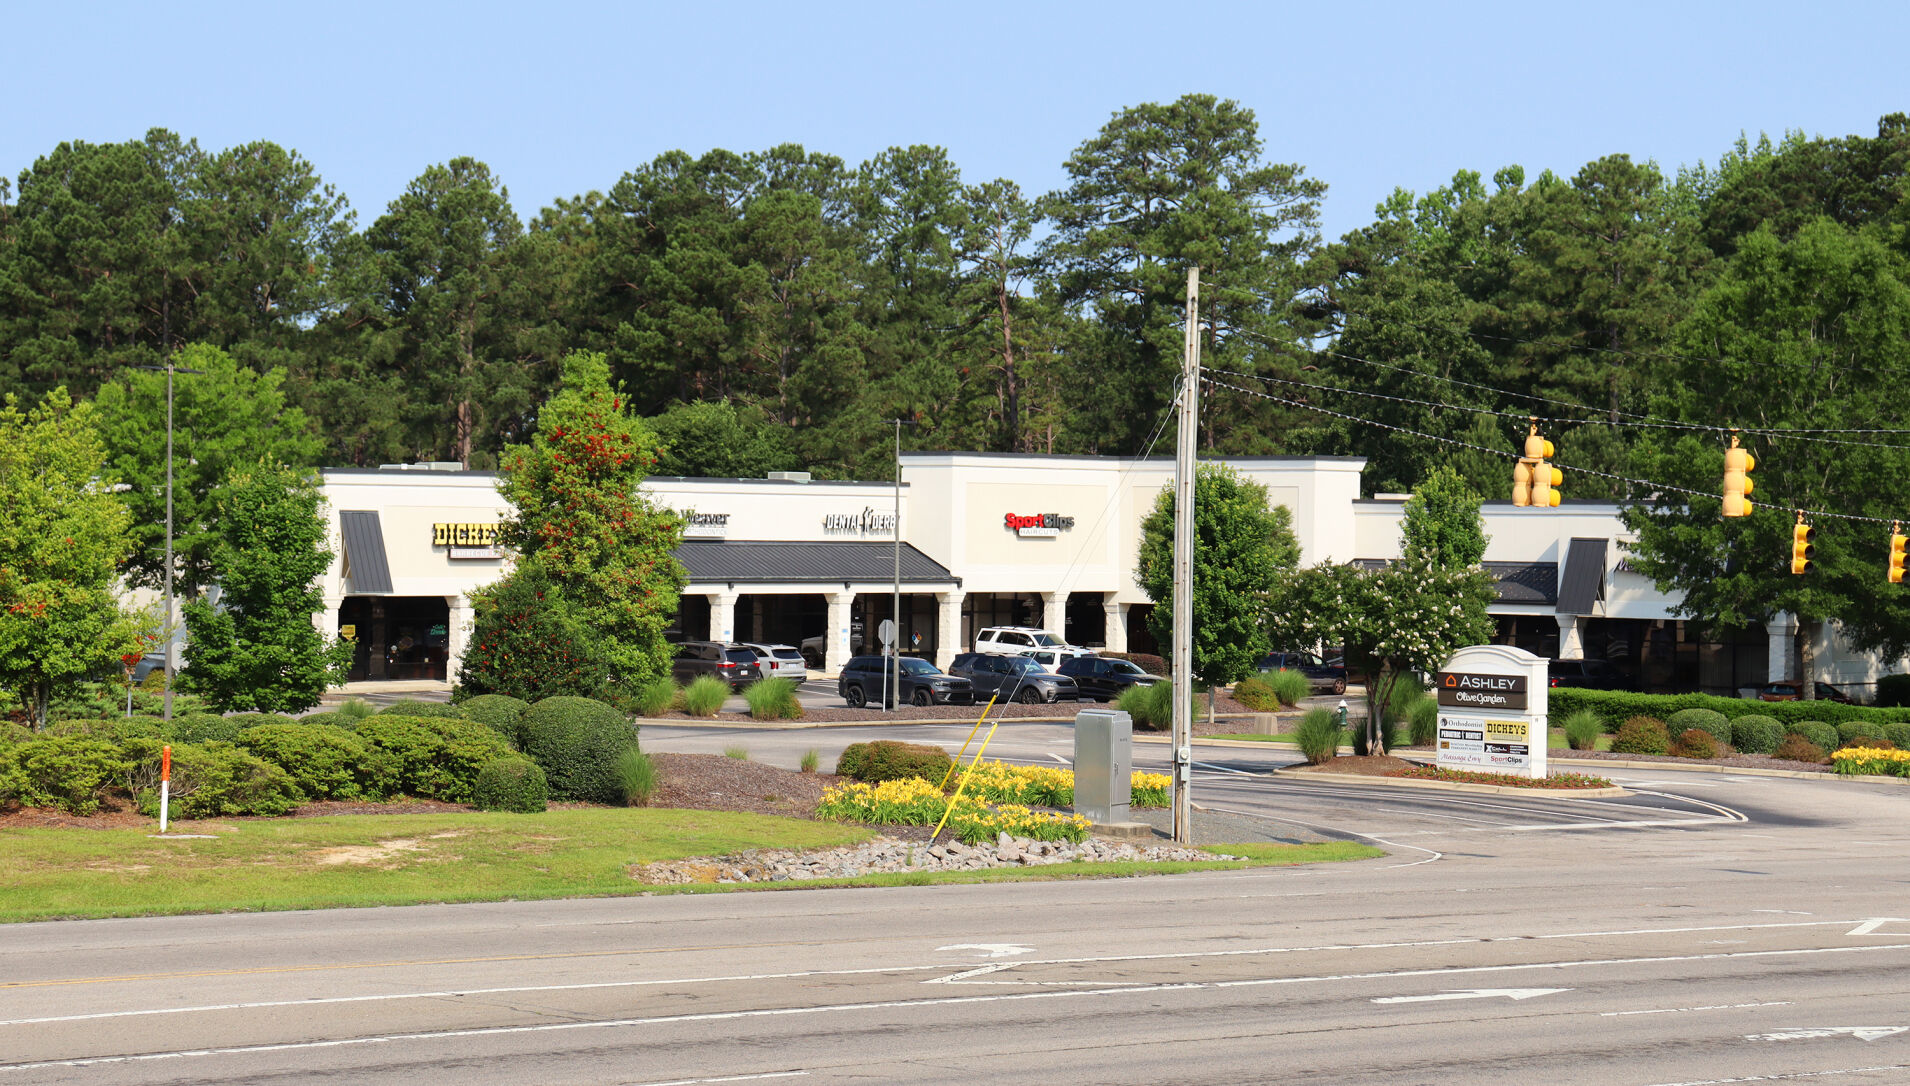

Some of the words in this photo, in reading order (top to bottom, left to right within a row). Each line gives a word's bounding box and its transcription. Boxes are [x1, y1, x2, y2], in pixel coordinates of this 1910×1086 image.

[825, 514, 861, 529] DENTAL
[870, 514, 900, 530] DERB
[433, 522, 514, 545] DICKEY
[1460, 675, 1516, 690] ASHLEY
[1448, 719, 1483, 728] Orthodontist
